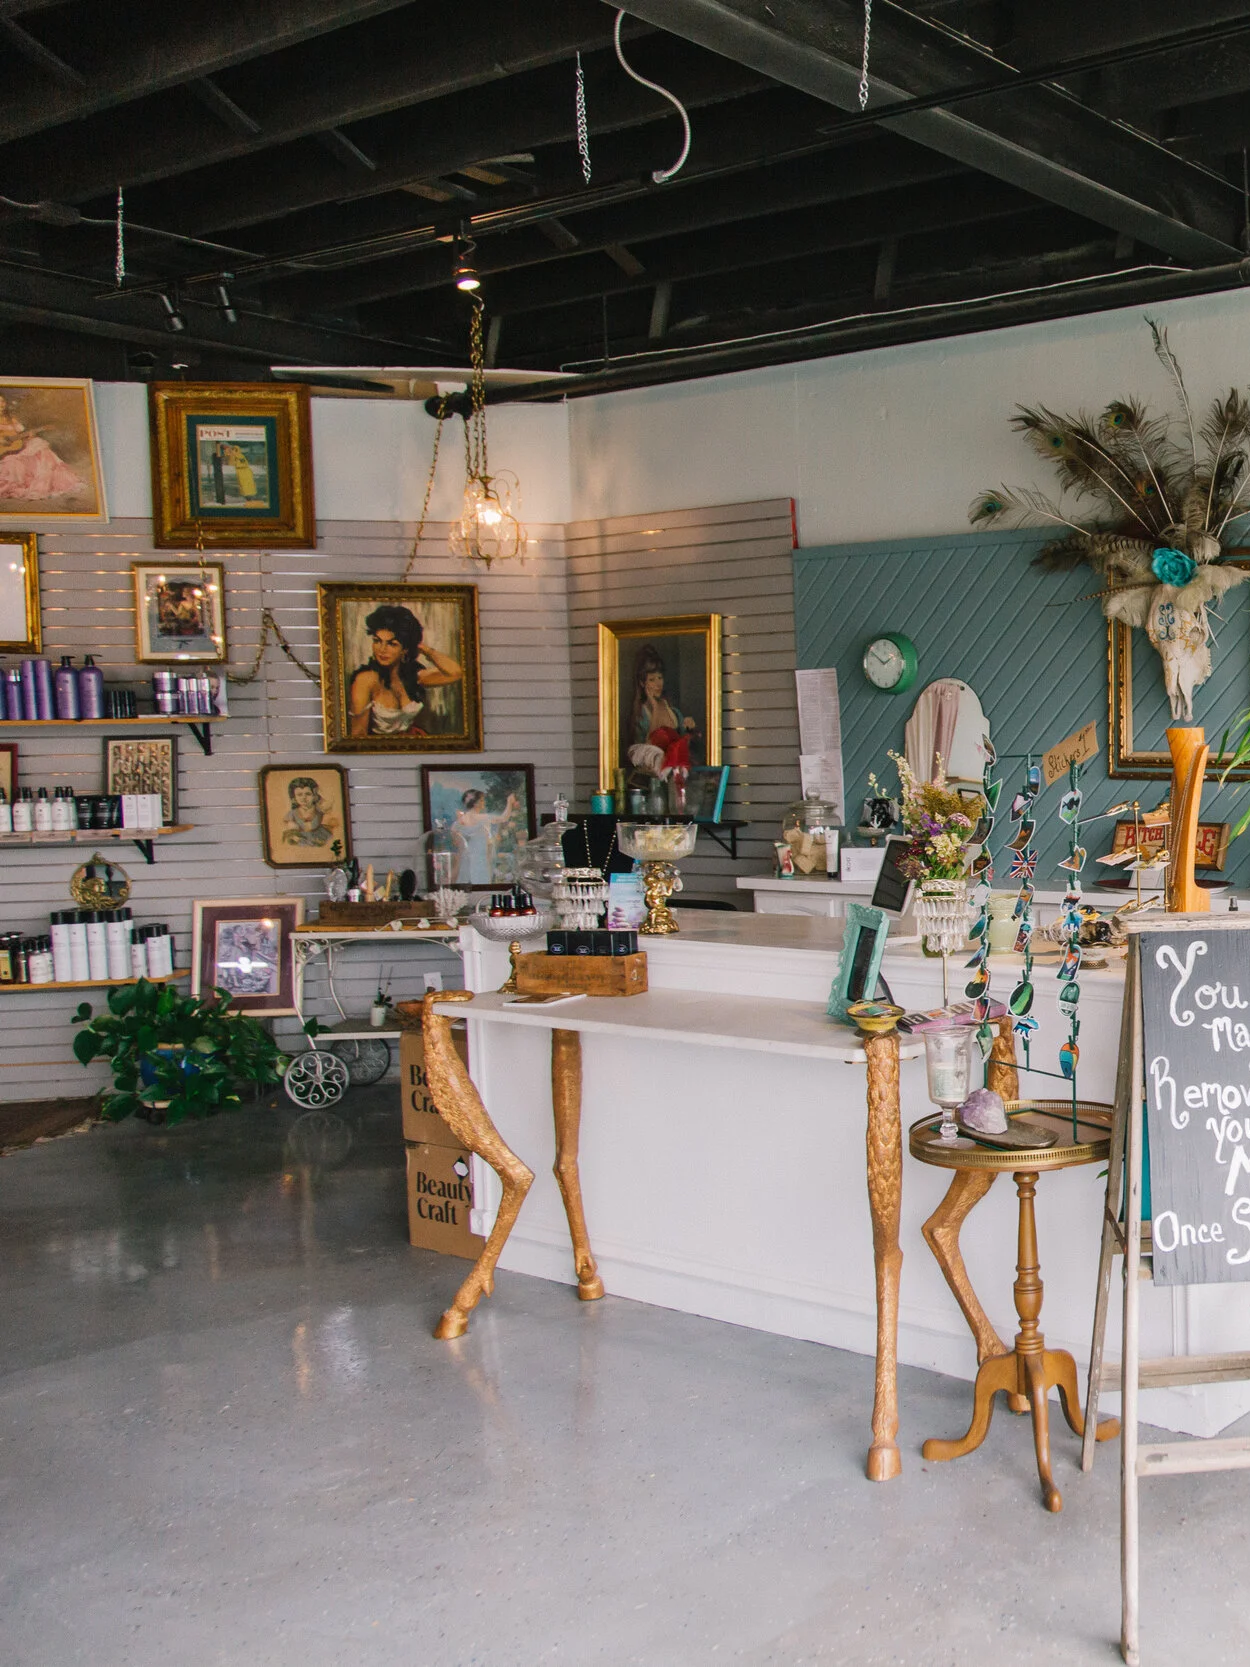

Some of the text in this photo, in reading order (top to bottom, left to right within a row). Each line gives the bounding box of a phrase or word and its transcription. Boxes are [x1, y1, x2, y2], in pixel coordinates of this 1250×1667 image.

[1156, 941, 1248, 1026] You
[411, 1090, 438, 1113] Cra
[416, 1171, 472, 1208] Beauty
[417, 1198, 459, 1226] Craft
[1154, 1211, 1225, 1252] Once
